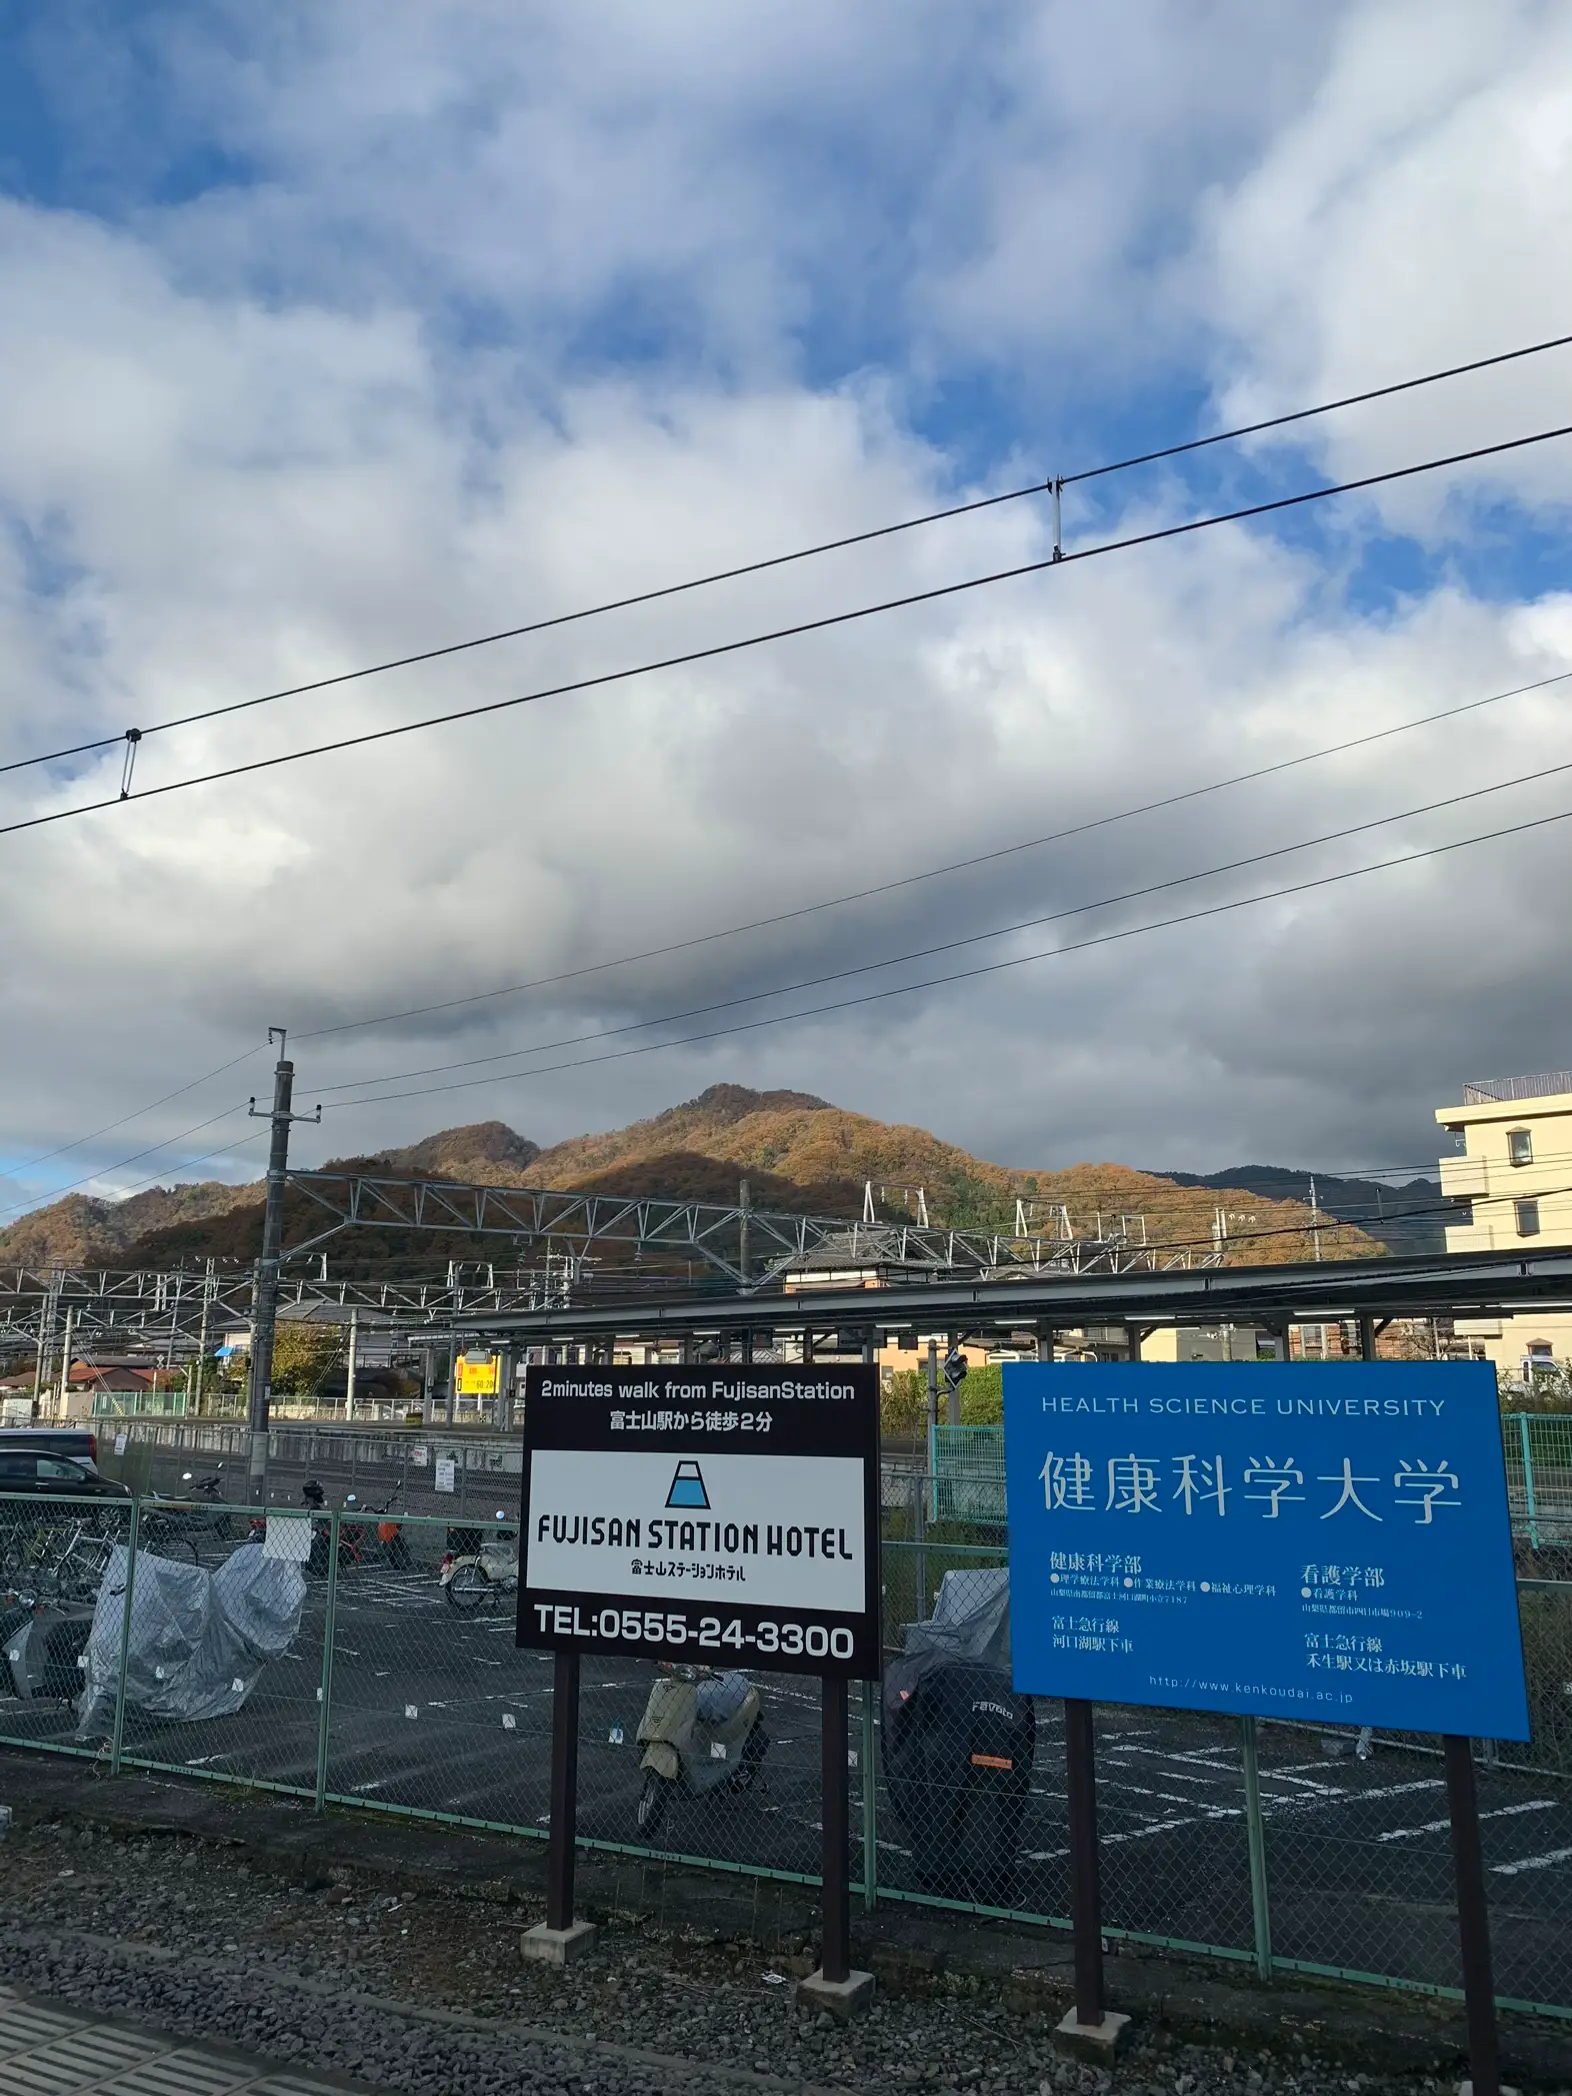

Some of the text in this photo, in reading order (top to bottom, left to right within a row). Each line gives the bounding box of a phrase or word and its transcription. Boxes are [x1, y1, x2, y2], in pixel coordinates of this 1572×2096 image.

[541, 1380, 855, 1402] 2minutes walk from FujisanStation
[1042, 1397, 1445, 1416] HEALTH SCIENCE UNIVERSITY
[610, 1410, 773, 1433] 富士山駅から徒歩2分
[1038, 1451, 1462, 1525] 健康科学大学
[538, 1514, 853, 1560] FUJISAN STATION HOTEL
[631, 1559, 746, 1582] 富士山ステーションホテル
[1050, 1551, 1142, 1575] 健康科学部
[1300, 1564, 1385, 1588] 看護学部
[533, 1603, 854, 1660] TEL:0555-24-3300
[1052, 1615, 1120, 1634] 富士急行線
[1052, 1633, 1134, 1654] 河口湖駅下車
[1304, 1632, 1383, 1653] 富士急行線
[1149, 1675, 1354, 1704] http://www.kenkoudai.ac.jp
